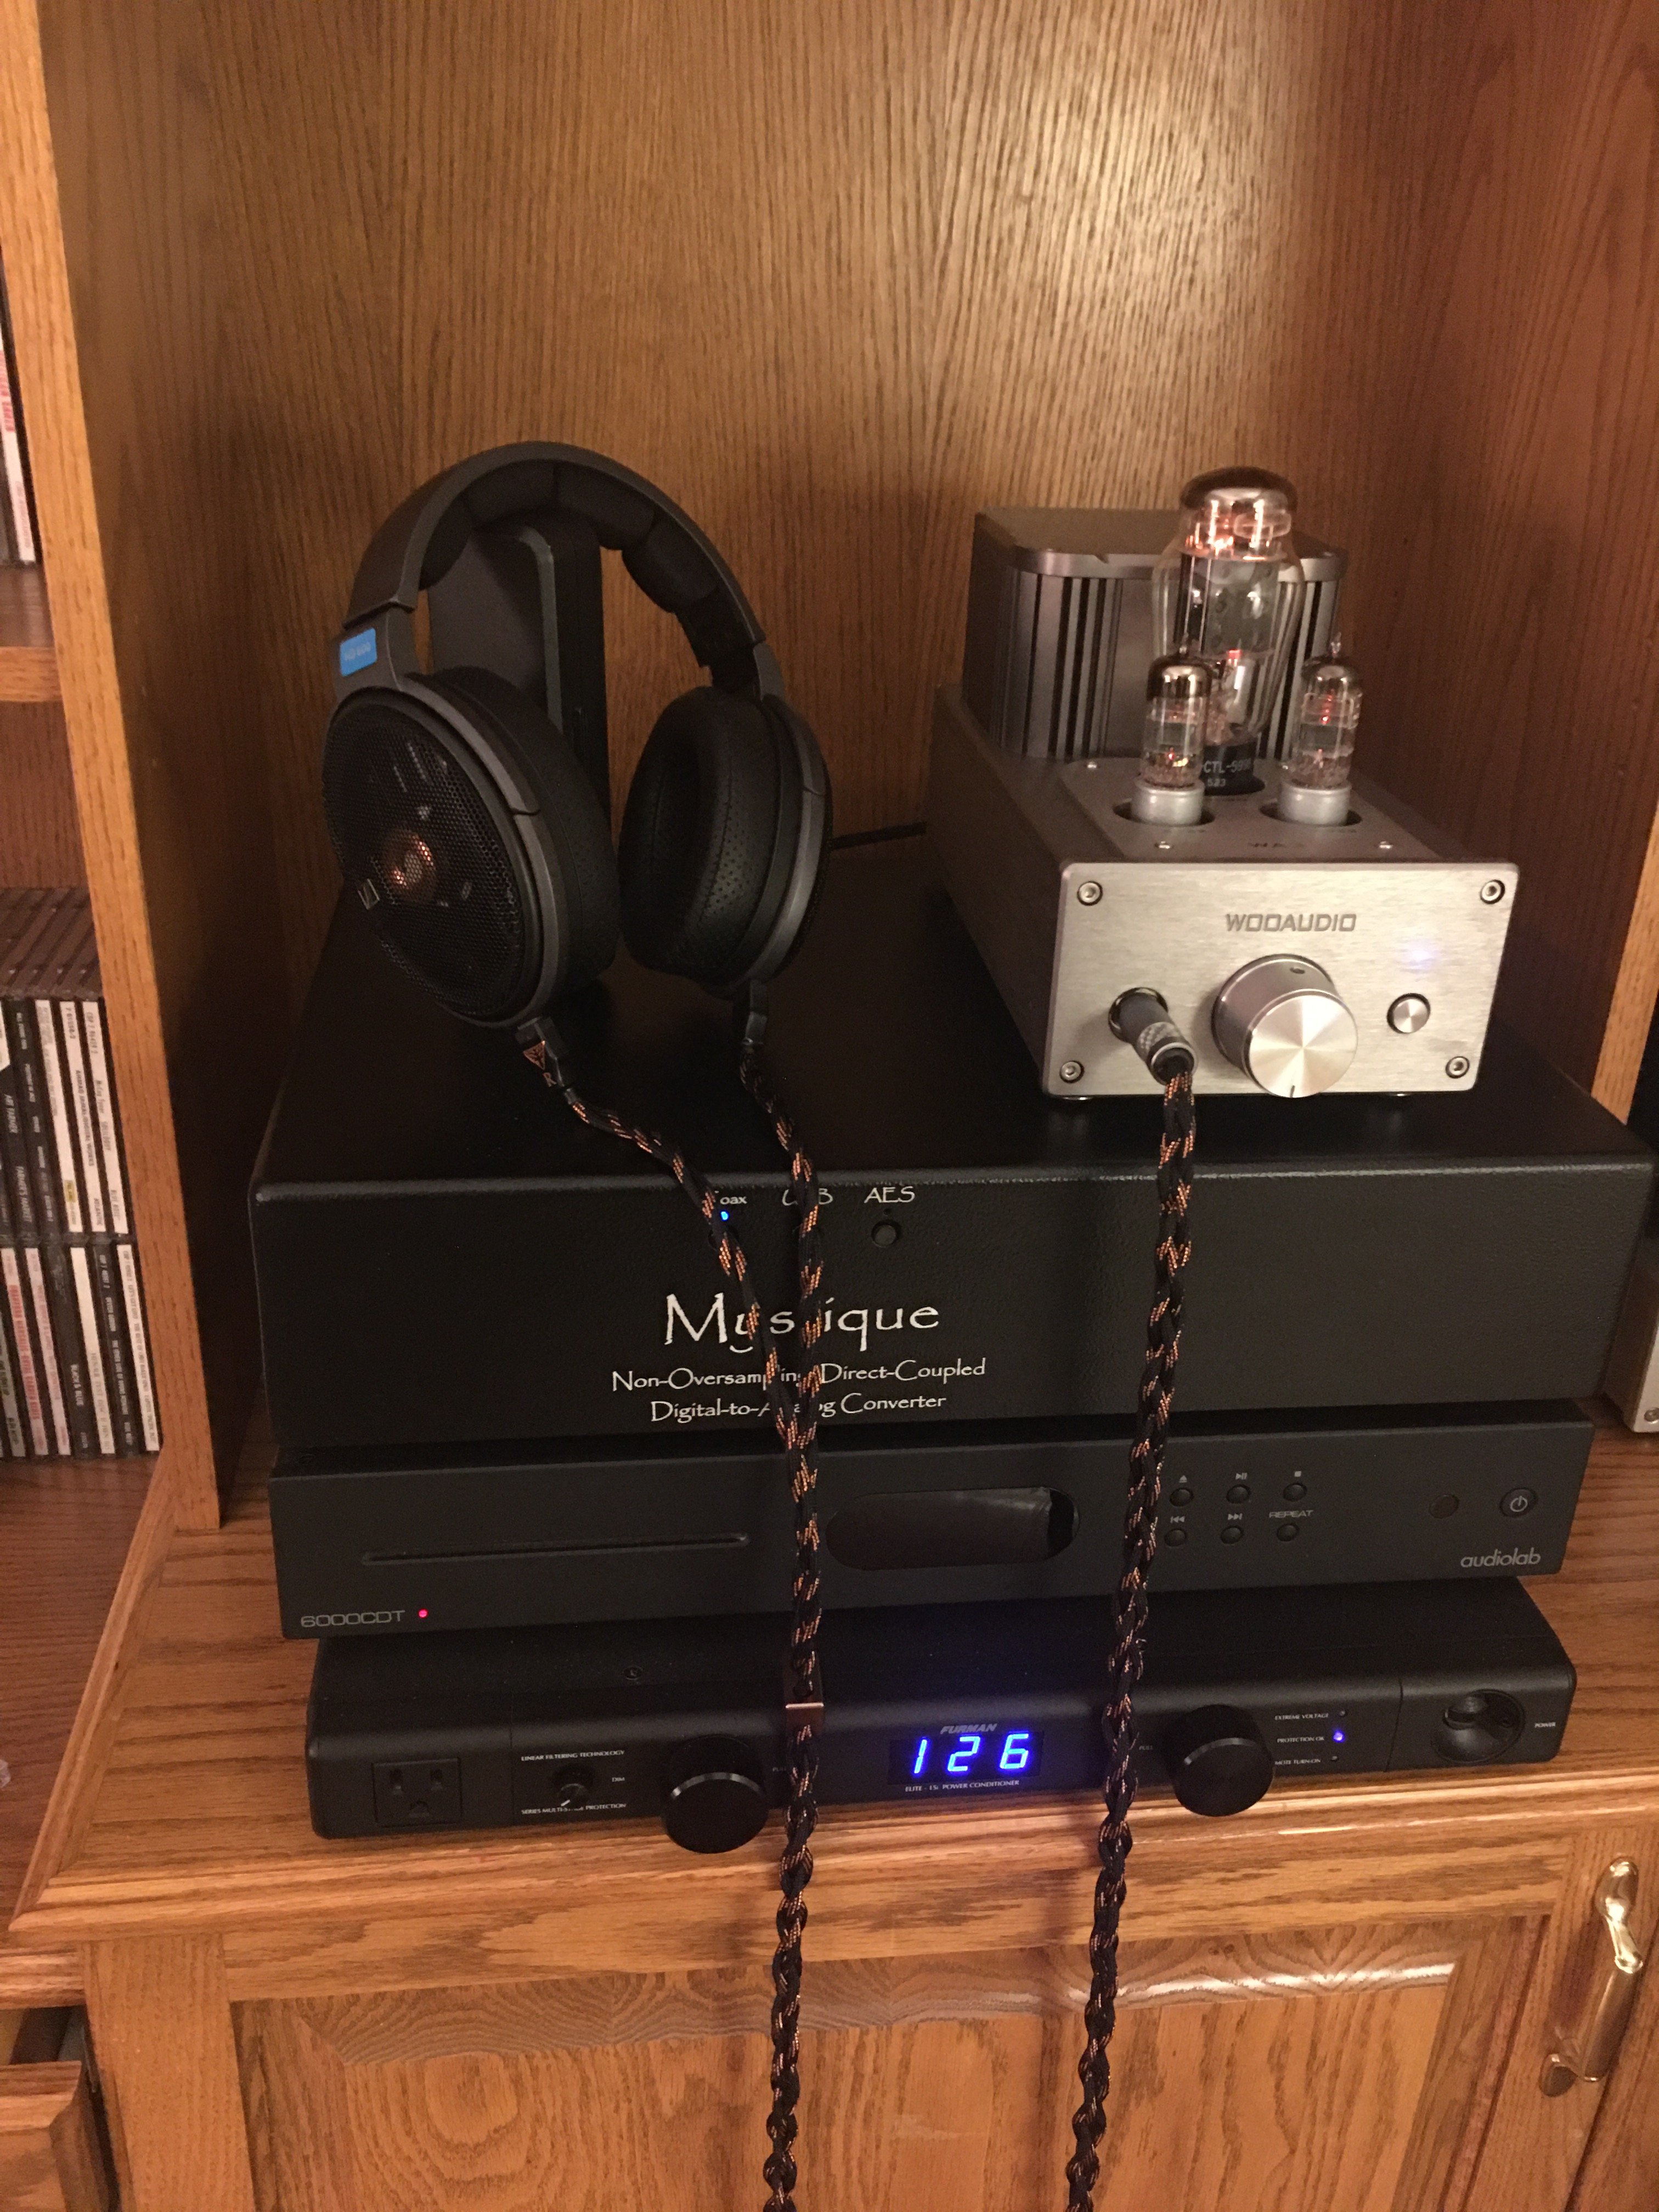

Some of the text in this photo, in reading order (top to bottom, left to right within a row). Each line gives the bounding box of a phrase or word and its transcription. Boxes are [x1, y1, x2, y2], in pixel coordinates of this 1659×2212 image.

[1226, 913, 1356, 932] WOOAUDIO
[714, 1186, 916, 1206] oax UB AES
[664, 1293, 940, 1353] Mysique
[820, 1358, 986, 1385] Direct-Coupled
[839, 1392, 947, 1414] Converter
[1269, 1510, 1314, 1519] REPEAT
[1460, 1547, 1541, 1567] audiolab
[301, 1610, 406, 1628] 6000CDT
[940, 1724, 998, 1735] FURMAN
[914, 1733, 1029, 1774] 126
[969, 1780, 1020, 1789] CONDITIONER
